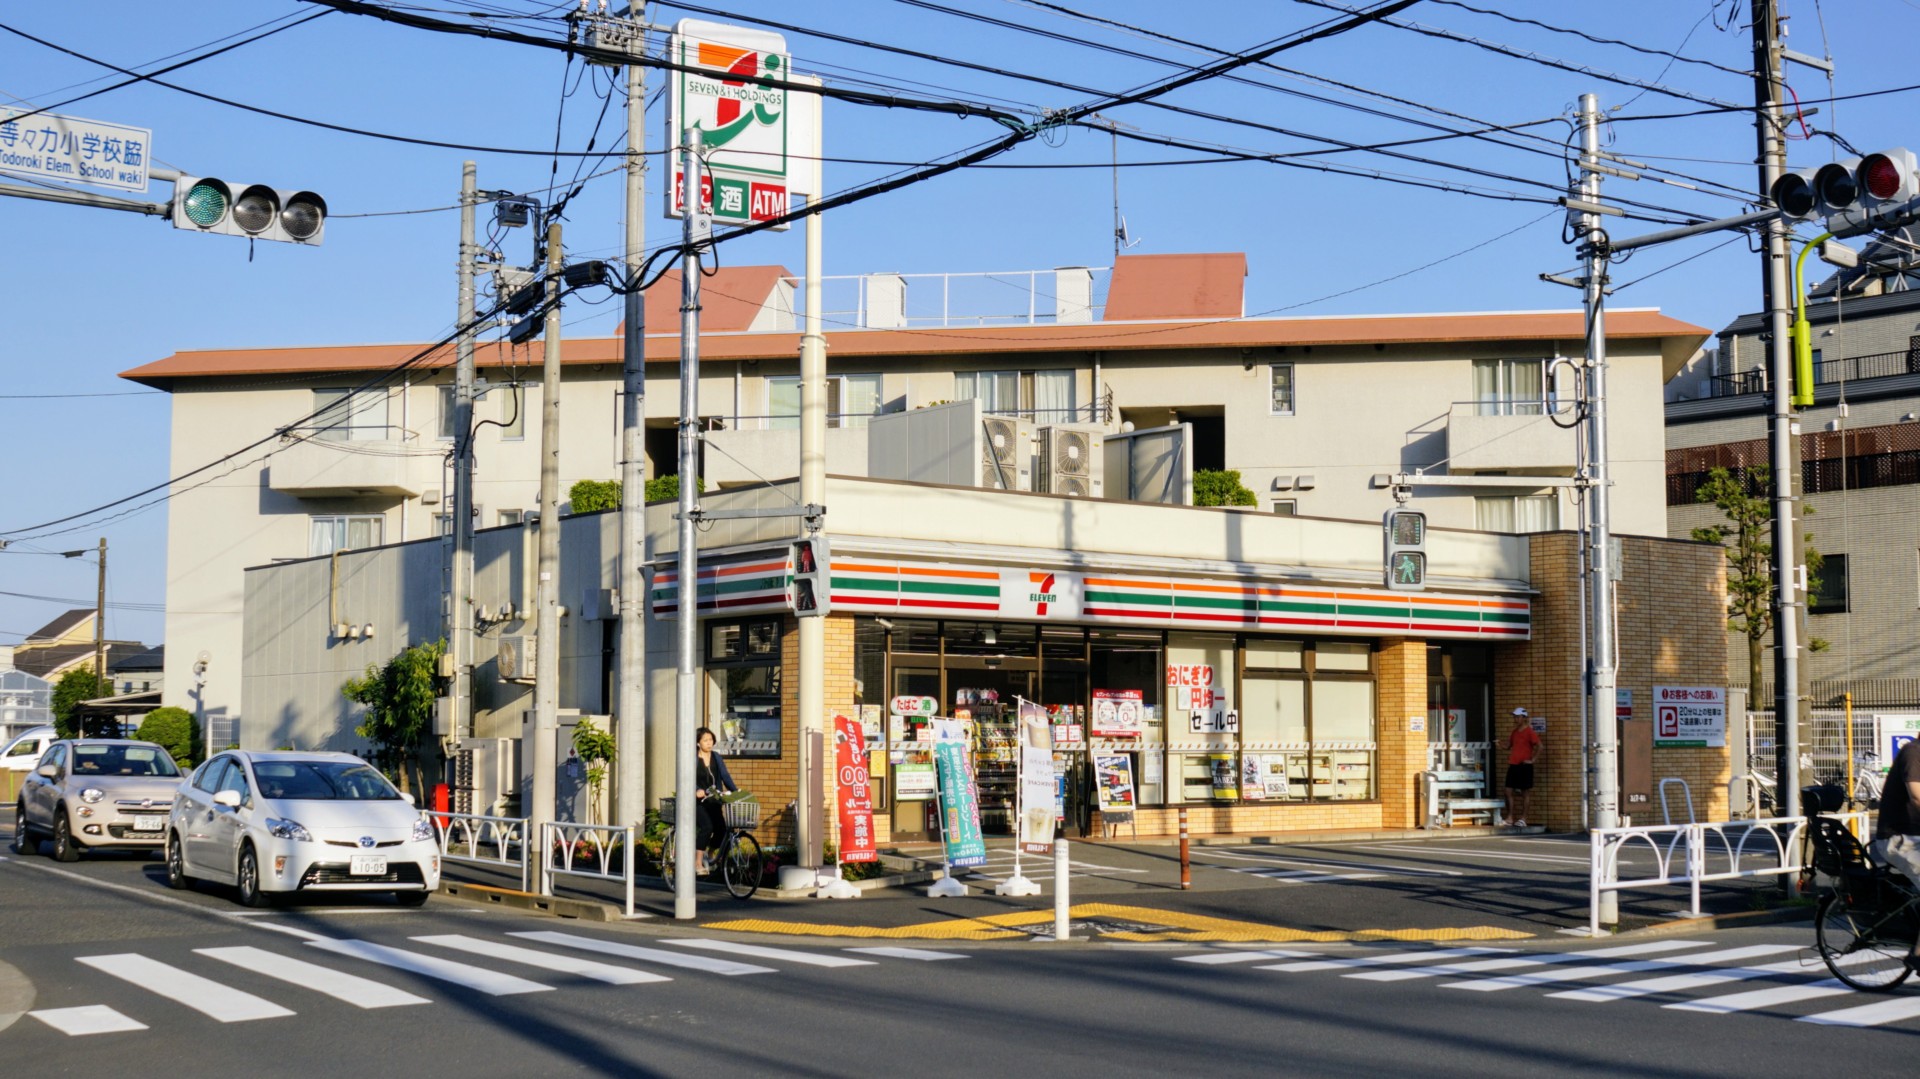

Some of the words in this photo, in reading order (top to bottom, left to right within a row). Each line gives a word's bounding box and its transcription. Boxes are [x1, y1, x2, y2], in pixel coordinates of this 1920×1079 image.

[0, 120, 142, 166] 等々力小学校脇
[46, 157, 75, 174] Elem.
[80, 161, 114, 181] School
[119, 170, 142, 184] waki
[720, 185, 743, 212] 酒
[752, 189, 784, 217] ATM
[1167, 664, 1213, 686] おにぎり
[896, 699, 918, 711] たばこ
[922, 699, 931, 711] 酒
[1192, 711, 1237, 730] セール中
[360, 863, 385, 873] 10-05
